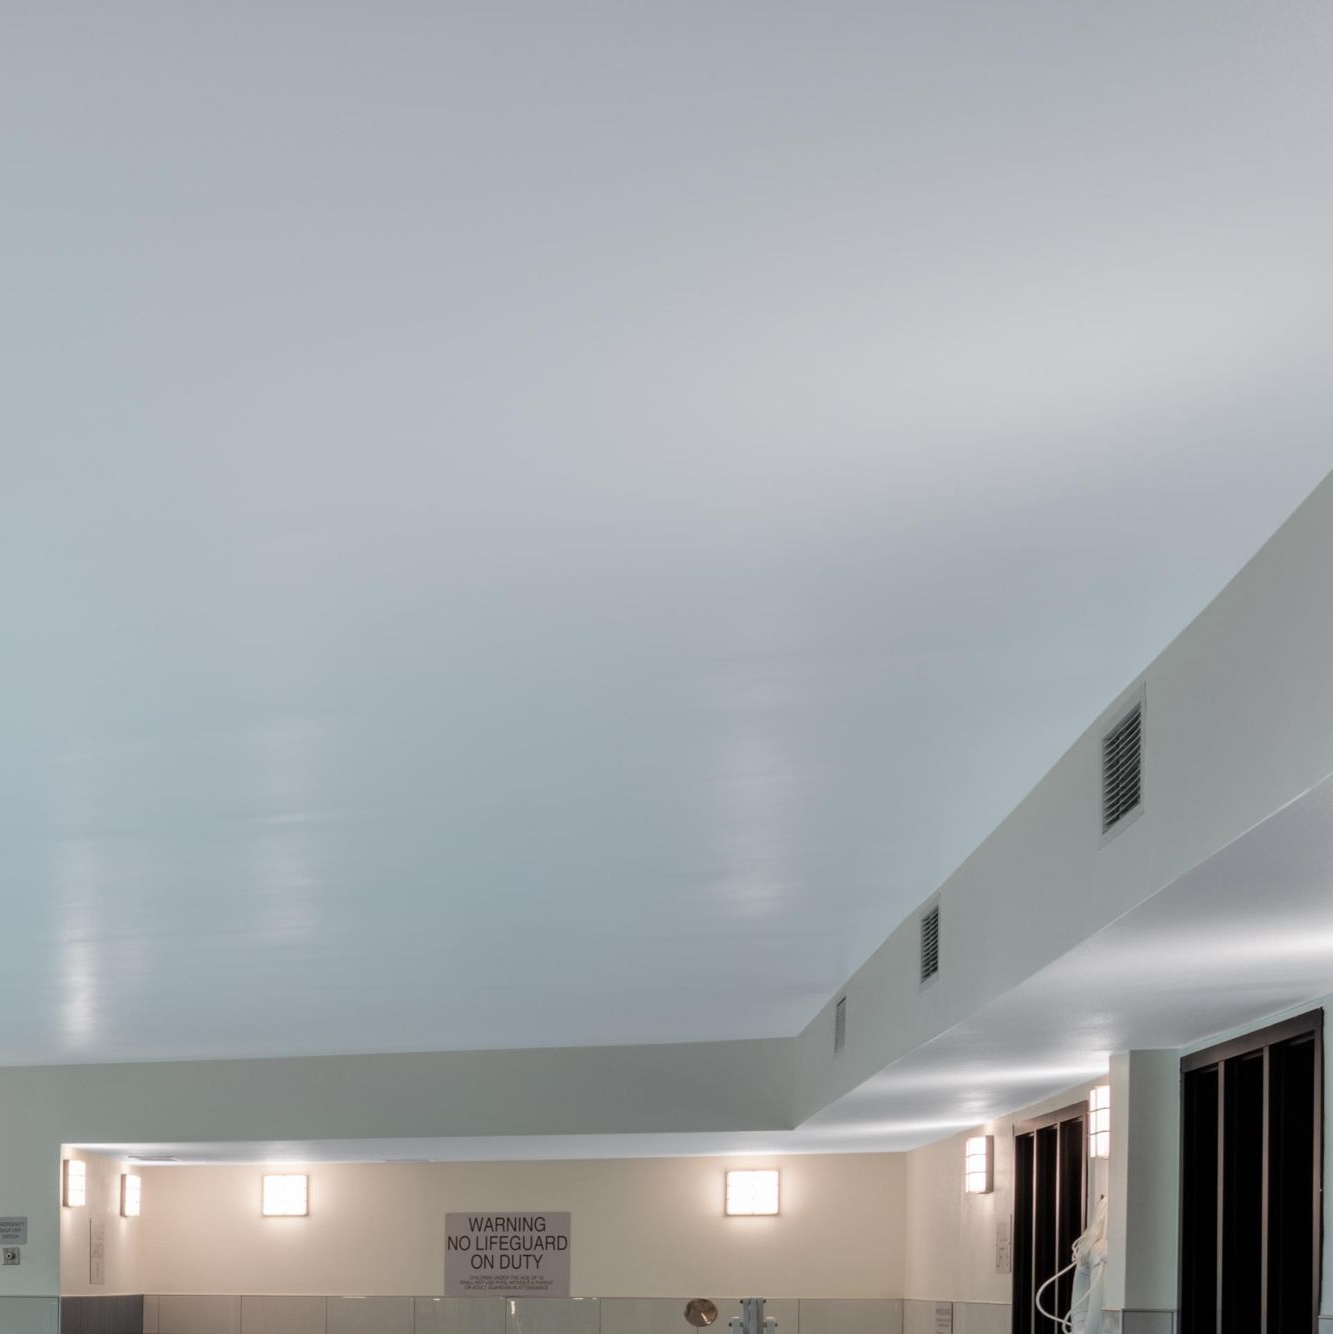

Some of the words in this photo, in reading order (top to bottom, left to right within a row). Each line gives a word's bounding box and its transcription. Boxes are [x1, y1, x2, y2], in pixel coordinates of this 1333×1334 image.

[468, 1216, 546, 1232] WARNING
[447, 1235, 471, 1251] NO
[476, 1235, 568, 1251] LIFEGUARD
[470, 1254, 495, 1269] ON
[499, 1254, 544, 1269] DUTY
